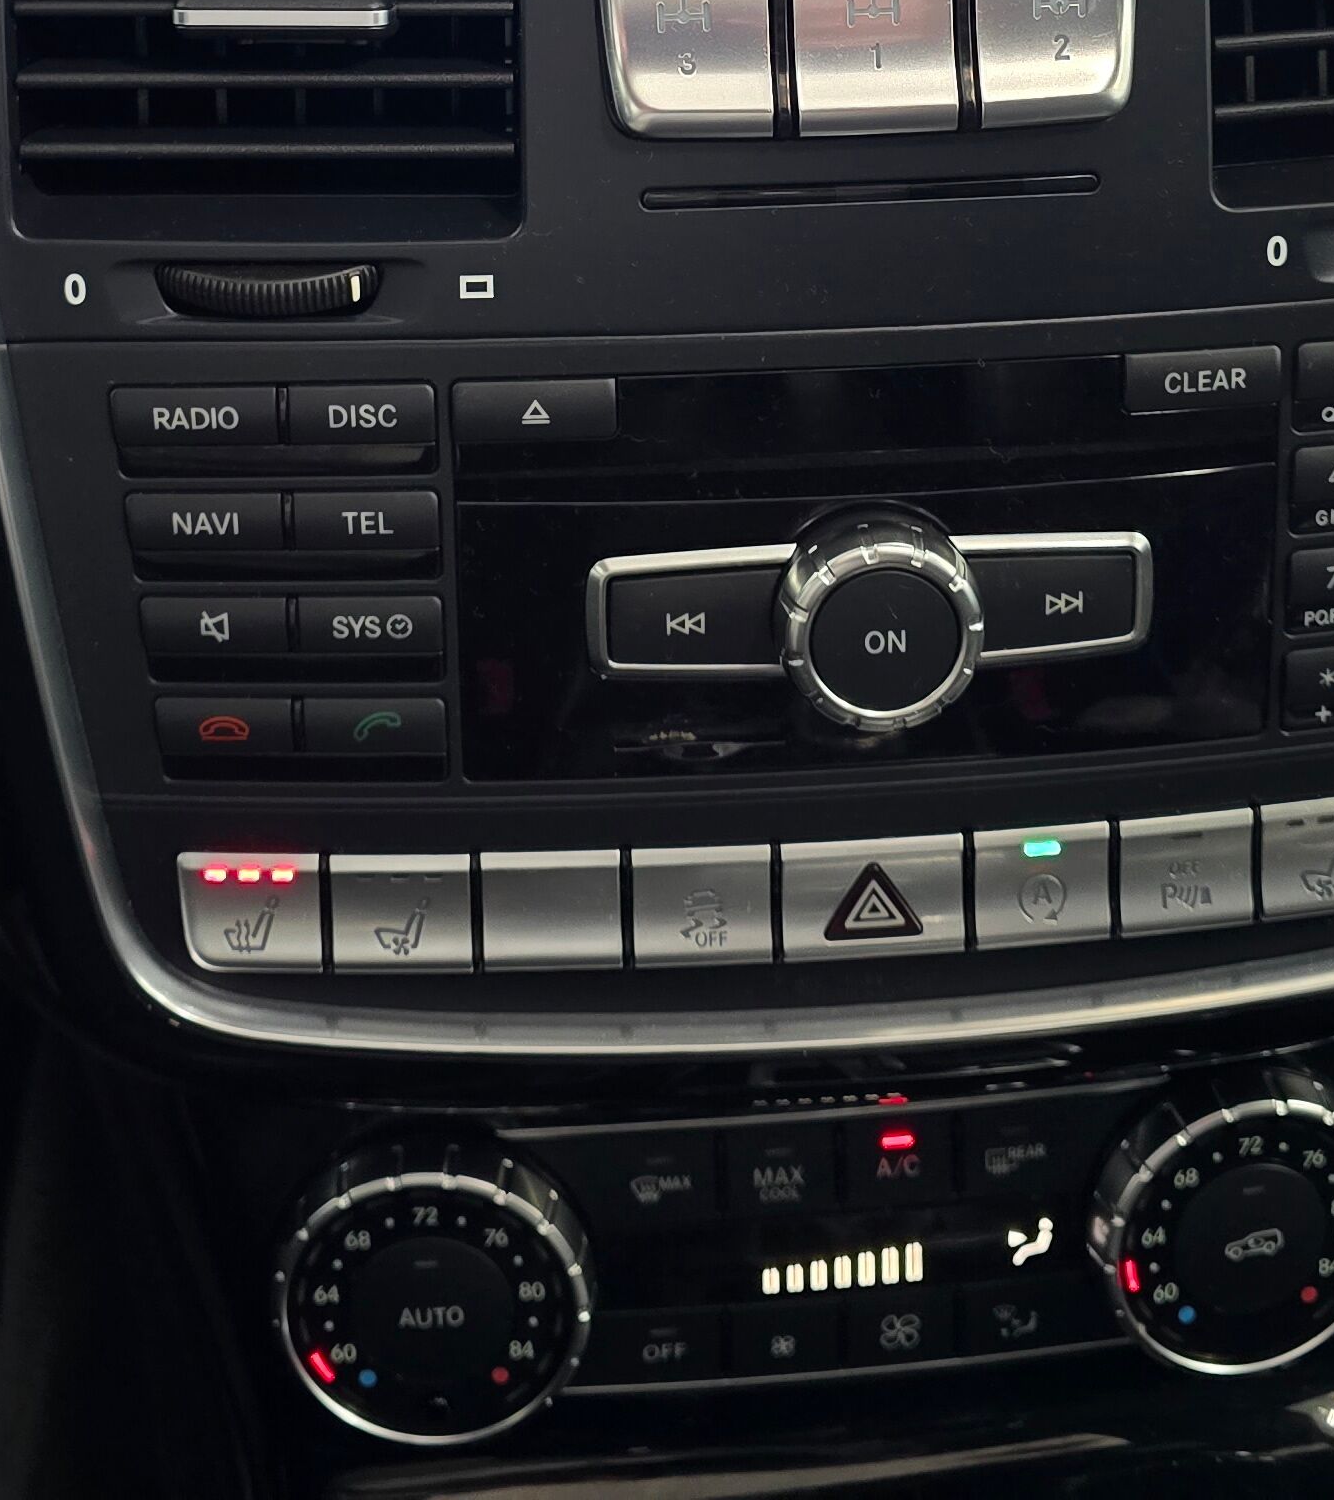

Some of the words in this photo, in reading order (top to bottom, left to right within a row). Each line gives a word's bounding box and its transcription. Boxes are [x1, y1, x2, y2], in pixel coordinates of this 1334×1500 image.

[870, 43, 884, 70] 1
[1054, 34, 1071, 62] 2
[678, 53, 696, 77] 3
[1267, 235, 1288, 267] 0
[65, 273, 87, 306] 0
[1164, 367, 1247, 394] CLEAR
[152, 406, 239, 432] RADIO
[327, 404, 398, 430] DISC
[172, 512, 240, 536] NAVI
[342, 511, 394, 535] TEL
[332, 615, 382, 640] SYS
[864, 630, 907, 655] ON
[695, 931, 728, 949] OFF
[1238, 1134, 1264, 1157] 72
[876, 1154, 921, 1179] A/C
[1302, 1148, 1327, 1170] 76
[753, 1165, 805, 1189] MAX
[1173, 1166, 1200, 1189] 68
[412, 1206, 439, 1227] 72
[344, 1230, 372, 1251] 68
[484, 1227, 509, 1248] 76
[1141, 1226, 1166, 1249] 64
[313, 1284, 340, 1306] 64
[518, 1281, 546, 1302] 80
[1153, 1281, 1179, 1305] 60
[398, 1305, 465, 1330] AUTO
[330, 1343, 357, 1363] 60
[508, 1339, 535, 1360] 84
[642, 1342, 687, 1363] OFF
